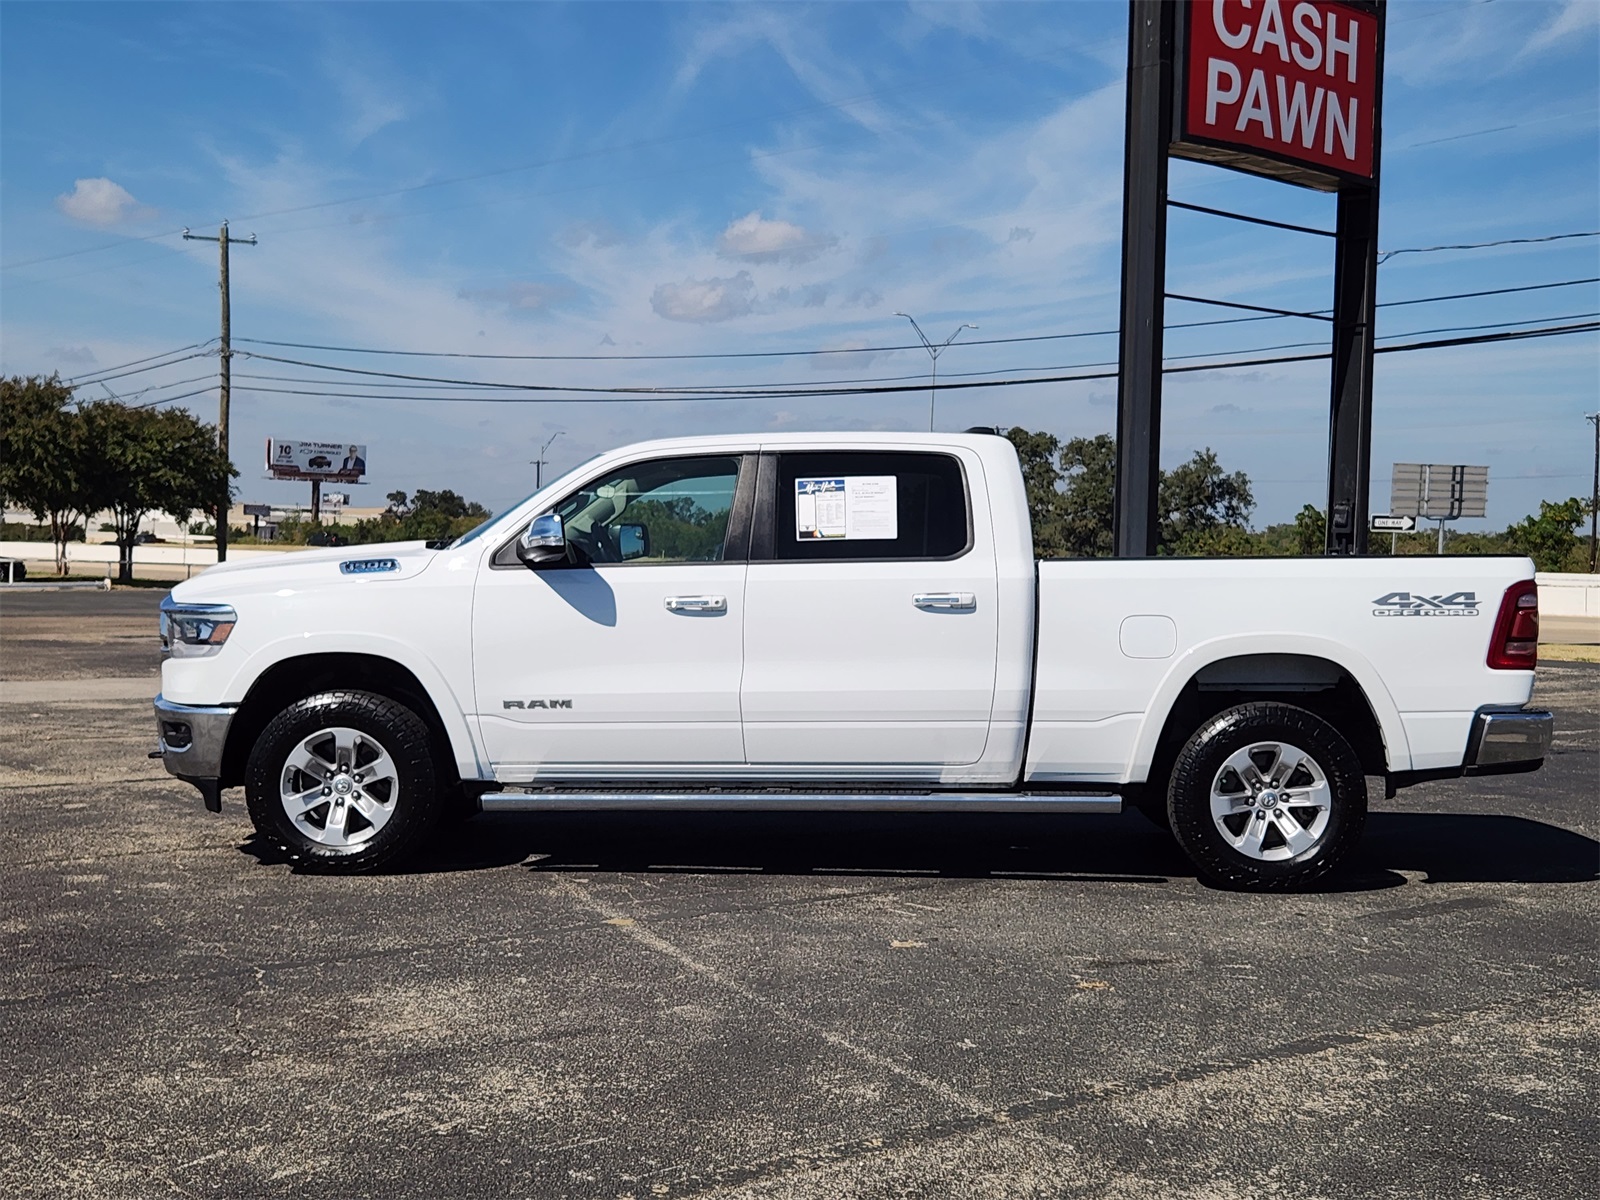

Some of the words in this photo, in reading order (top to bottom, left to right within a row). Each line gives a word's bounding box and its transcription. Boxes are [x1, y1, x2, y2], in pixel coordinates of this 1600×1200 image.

[1212, 0, 1358, 83] CASH
[1205, 57, 1358, 160] PAWN
[279, 444, 292, 455] 10
[313, 442, 342, 450] TURNER
[503, 699, 572, 709] RAM
